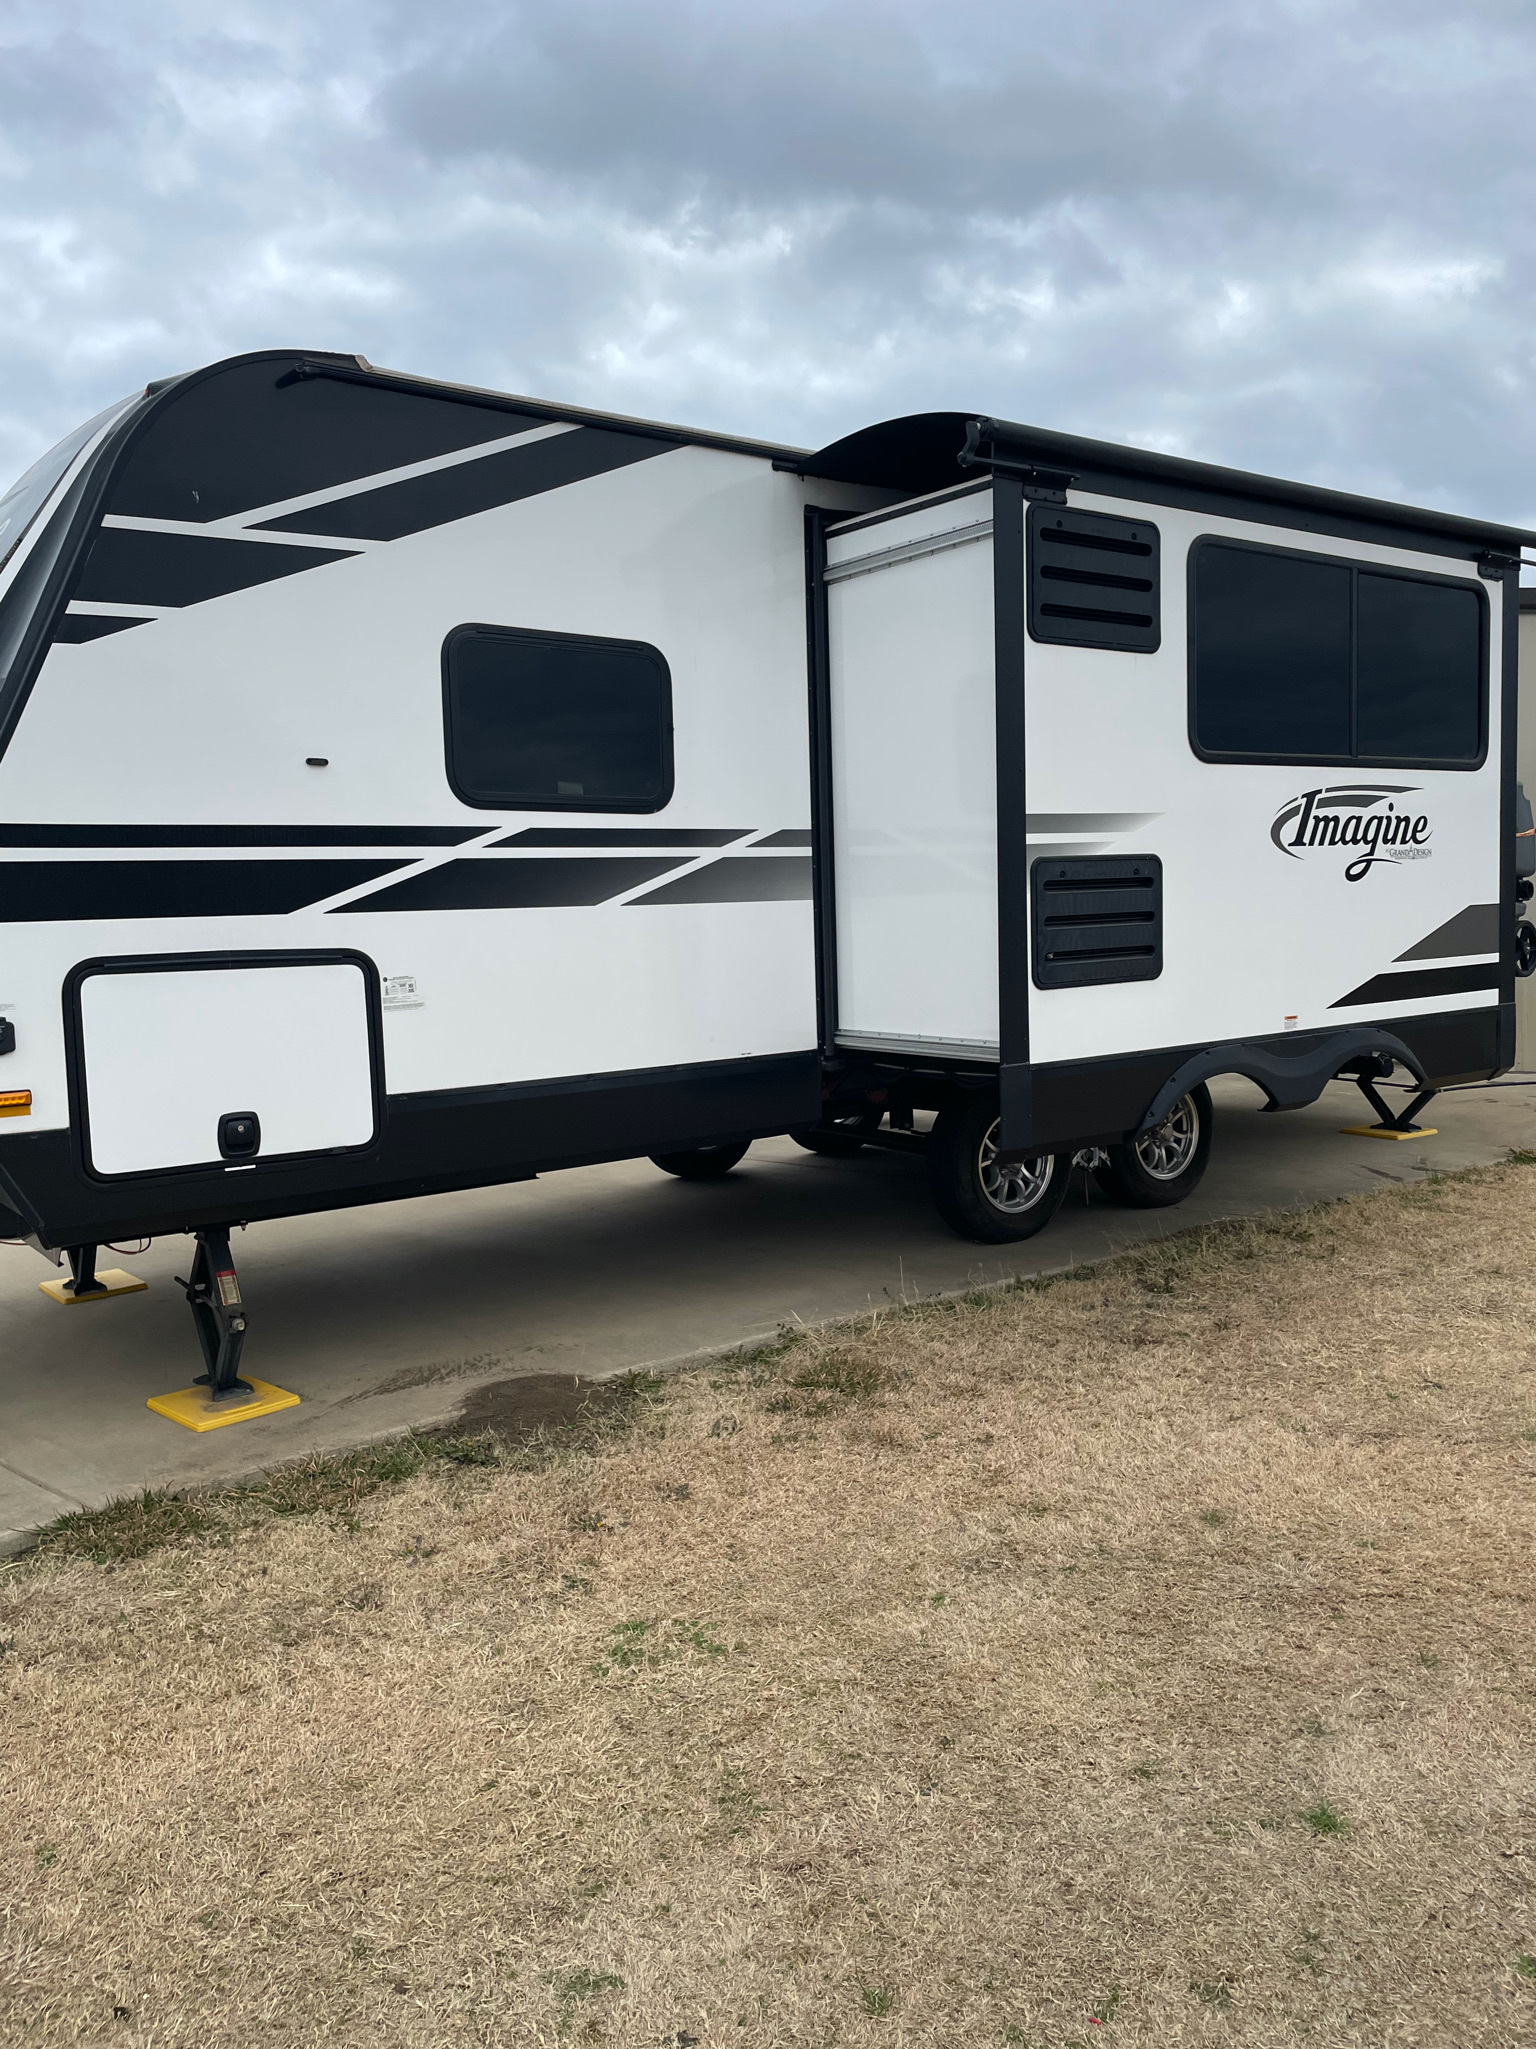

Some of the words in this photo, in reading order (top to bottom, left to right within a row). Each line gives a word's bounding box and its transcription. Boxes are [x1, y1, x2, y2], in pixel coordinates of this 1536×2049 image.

[1288, 788, 1433, 882] Imagine
[1390, 848, 1410, 857] GRAND
[1413, 848, 1432, 856] DESIGN
